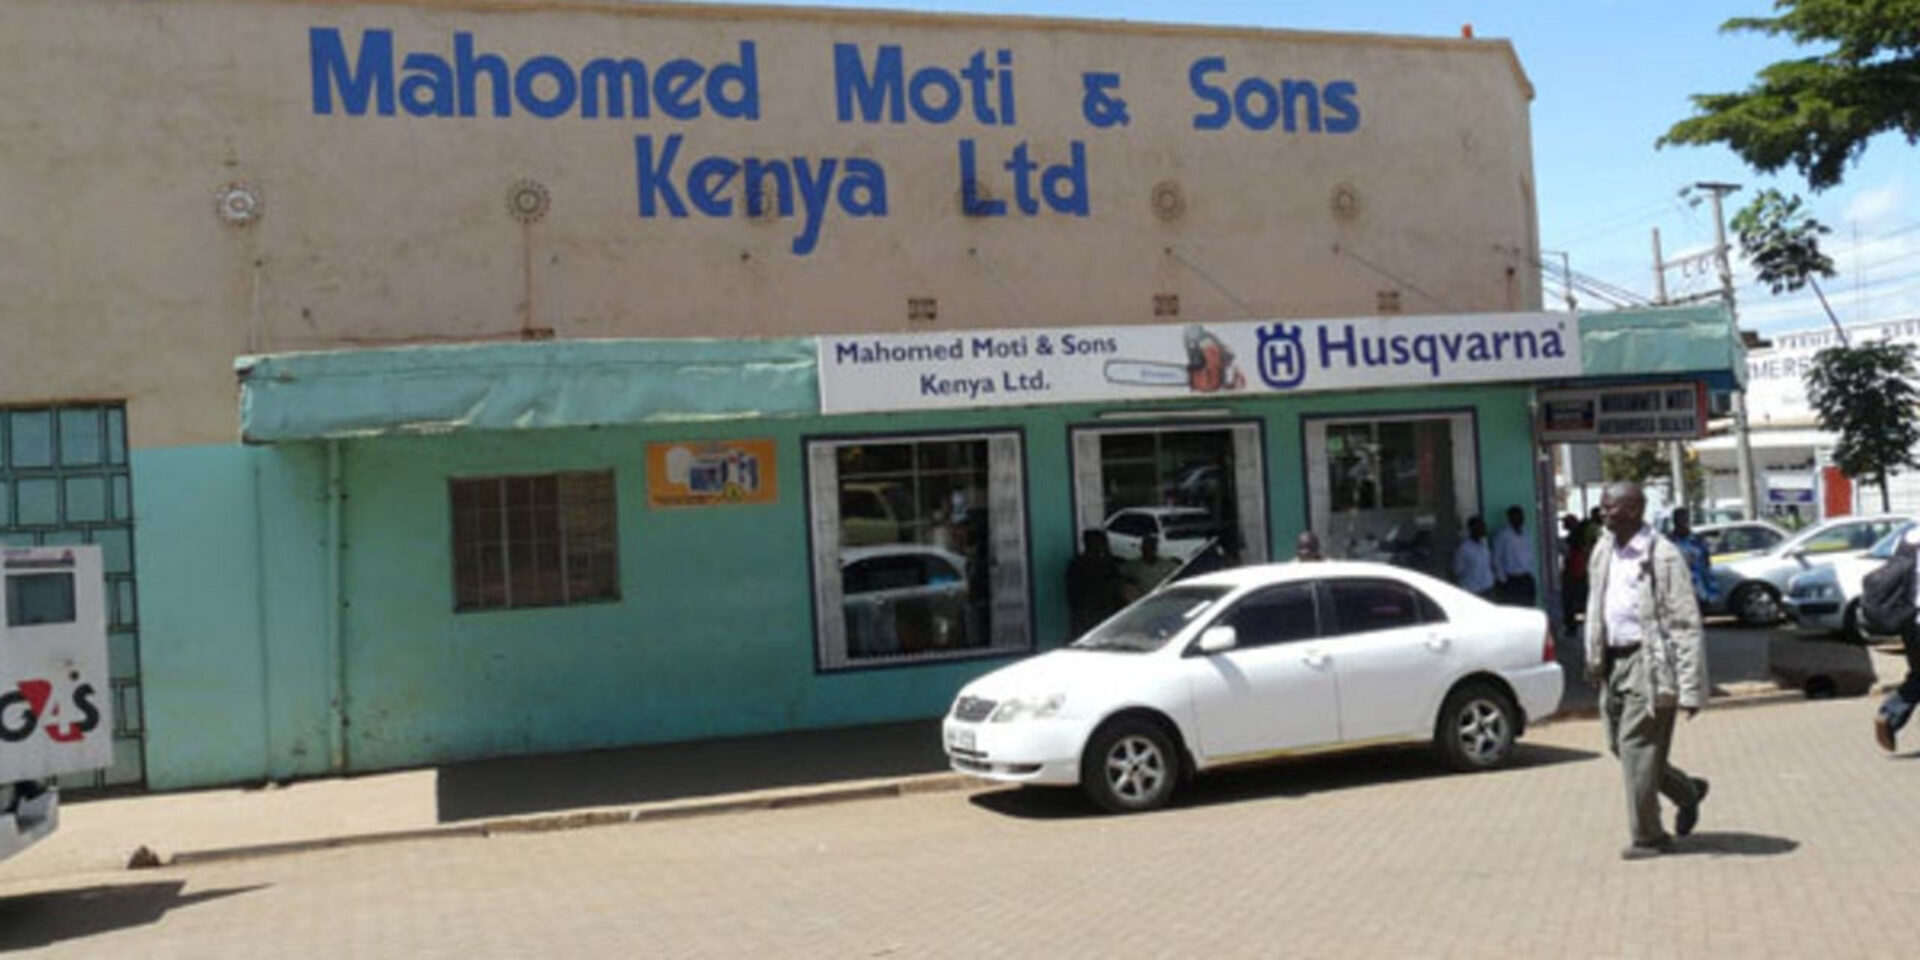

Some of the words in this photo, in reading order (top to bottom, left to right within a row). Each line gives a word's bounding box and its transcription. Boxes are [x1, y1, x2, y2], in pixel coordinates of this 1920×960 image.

[309, 27, 761, 121] Mahomed
[833, 42, 1017, 127] Moti
[1082, 72, 1130, 129] &
[1189, 56, 1361, 134] Sons
[635, 134, 889, 256] Kenya
[958, 139, 1091, 217] Ltd
[835, 339, 965, 365] Mahomed
[972, 336, 1029, 360] Moti
[1036, 335, 1055, 356] &
[1061, 333, 1118, 356] Sons
[1317, 324, 1566, 377] Husqvarna
[920, 374, 995, 399] Kenya
[1003, 370, 1051, 393] Ltd.
